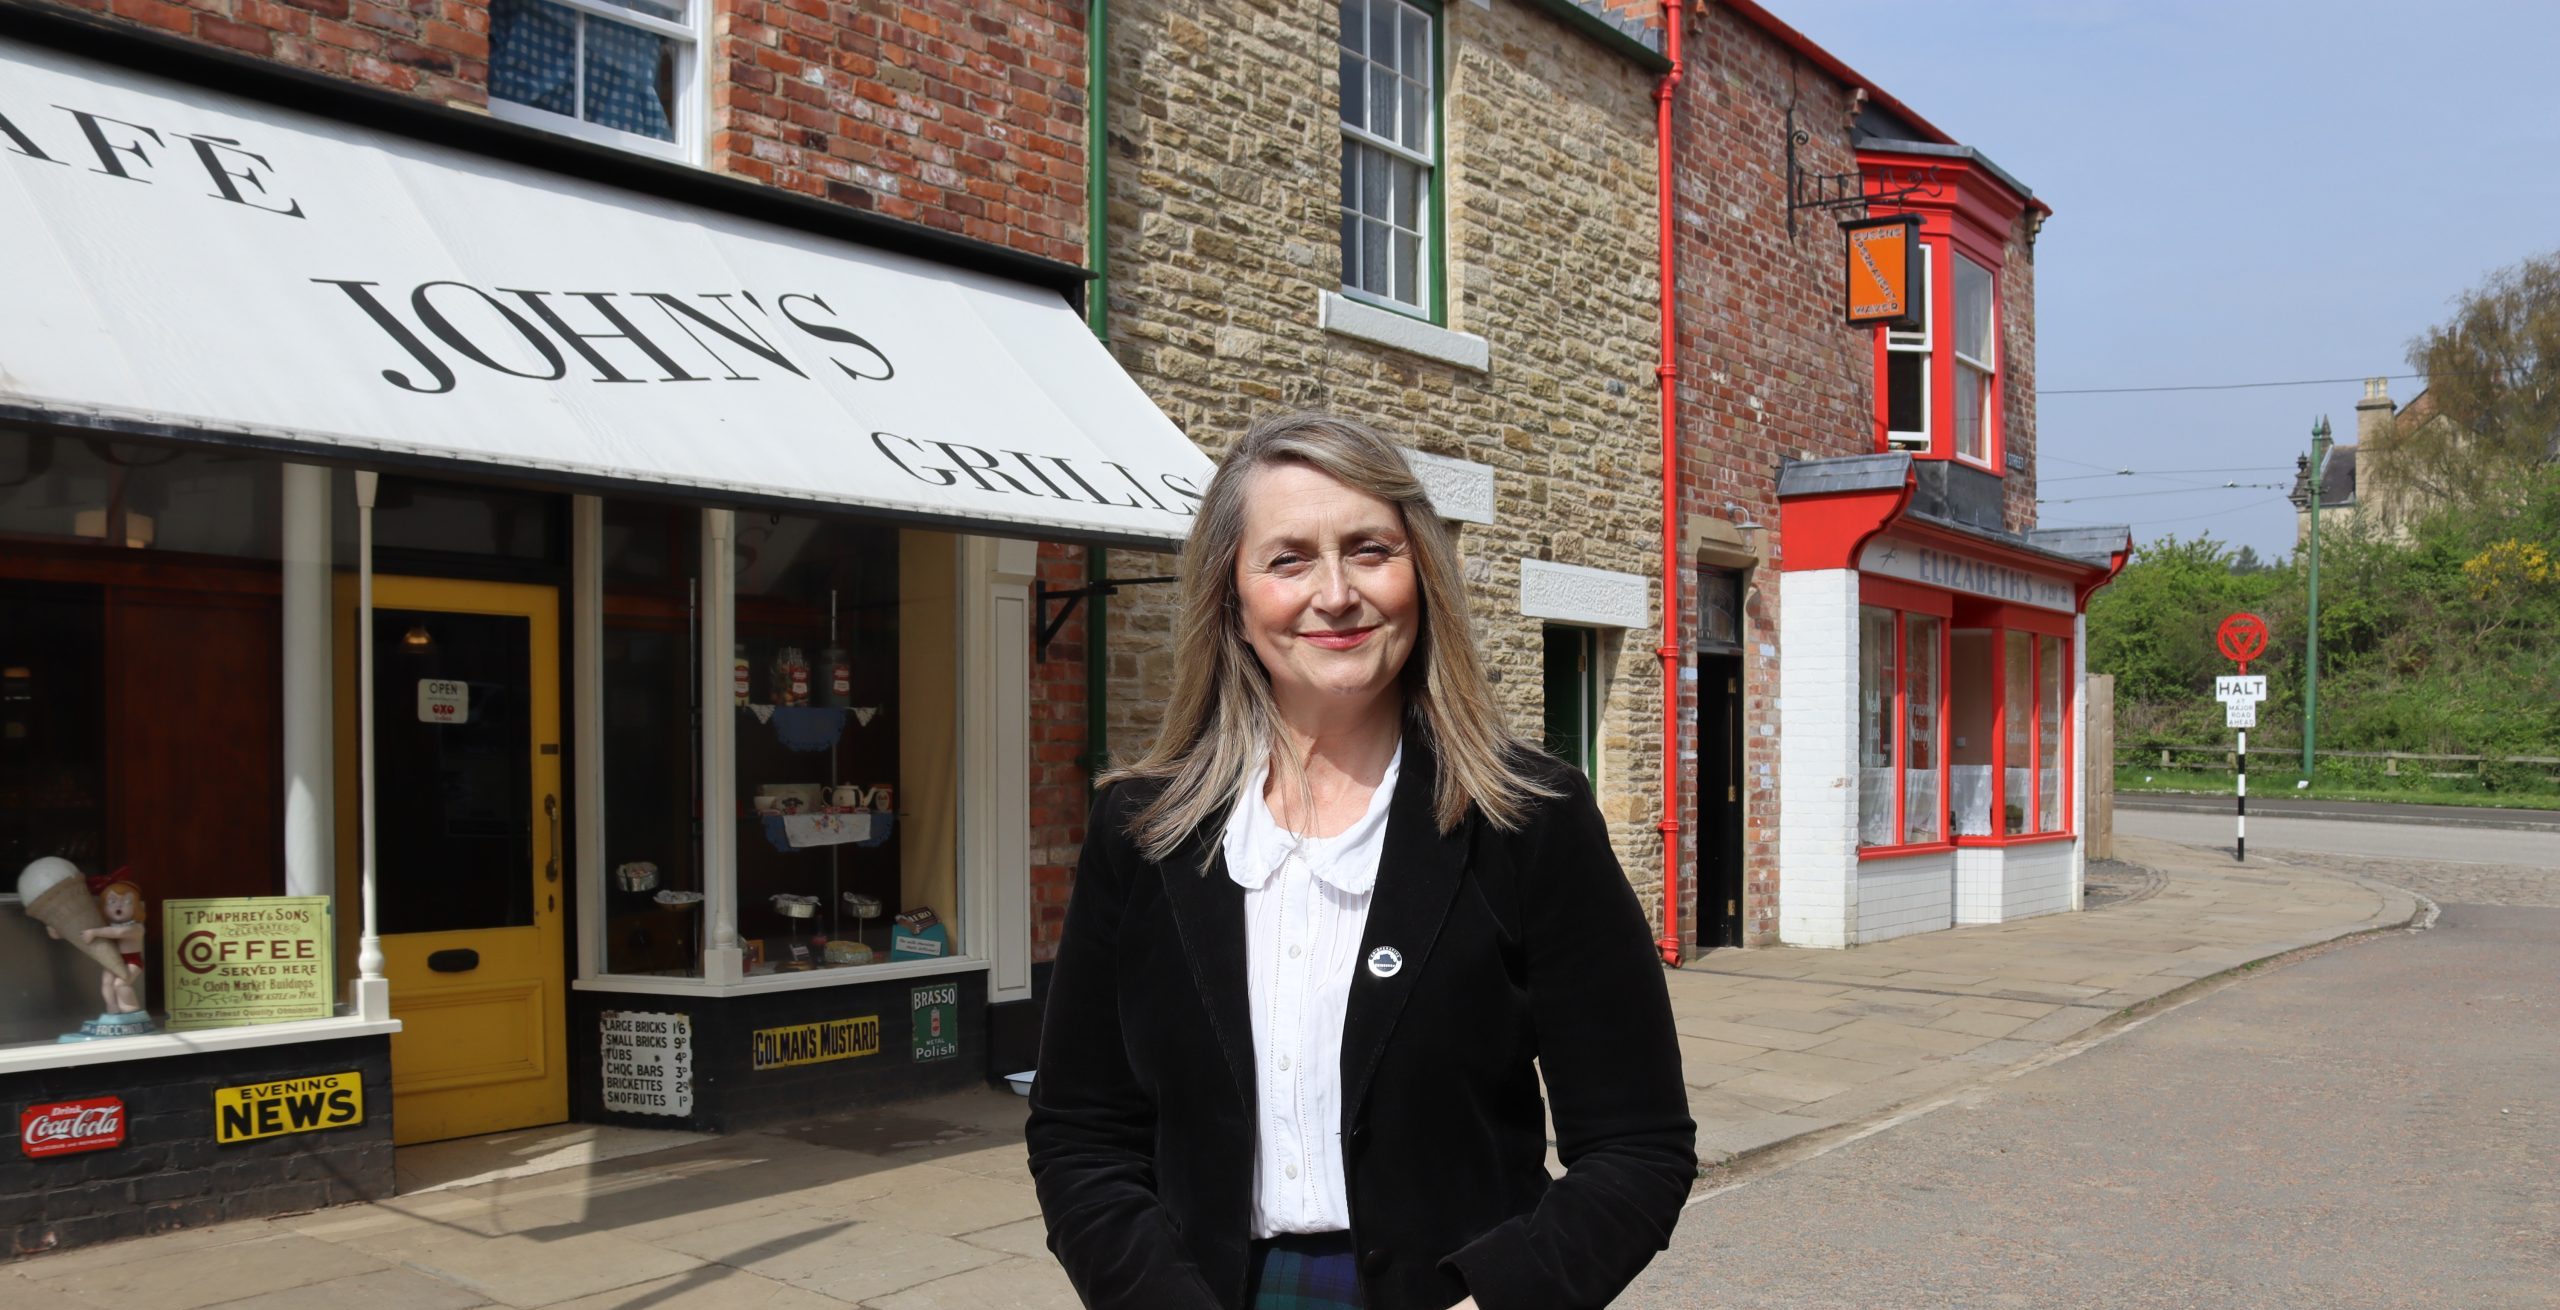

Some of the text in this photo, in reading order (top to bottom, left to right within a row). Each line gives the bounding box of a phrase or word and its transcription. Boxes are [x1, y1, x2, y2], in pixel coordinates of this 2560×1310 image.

[310, 278, 895, 394] JOHN'S
[871, 431, 1206, 516] GRILLS
[1919, 548, 2033, 602] ELIZABETH'S
[429, 682, 458, 695] OPEN
[2219, 682, 2263, 695] HALT
[432, 704, 454, 714] OXO
[197, 910, 266, 923] PUMPHREY
[177, 930, 315, 974] COFFEE
[219, 964, 317, 976] SERVED HERE
[203, 980, 230, 993] Cloth
[234, 979, 266, 992] Market
[270, 978, 313, 990] Buildings
[914, 988, 955, 1010] BRASSO
[605, 1020, 632, 1032] LARGE
[635, 1021, 667, 1034] BRICKS
[606, 1034, 633, 1046] SMALL
[635, 1036, 667, 1048] BRICKS
[755, 1021, 877, 1066] COLMAN'S MUSTARD
[606, 1048, 632, 1060] TUBS
[916, 1043, 955, 1059] Polish
[637, 1065, 664, 1077] BARS
[241, 1077, 338, 1100] EVENING
[607, 1077, 663, 1091] BRICKETTES
[608, 1091, 666, 1106] SNOFRUTES
[51, 1105, 81, 1116] Drink
[222, 1089, 356, 1139] NEWS
